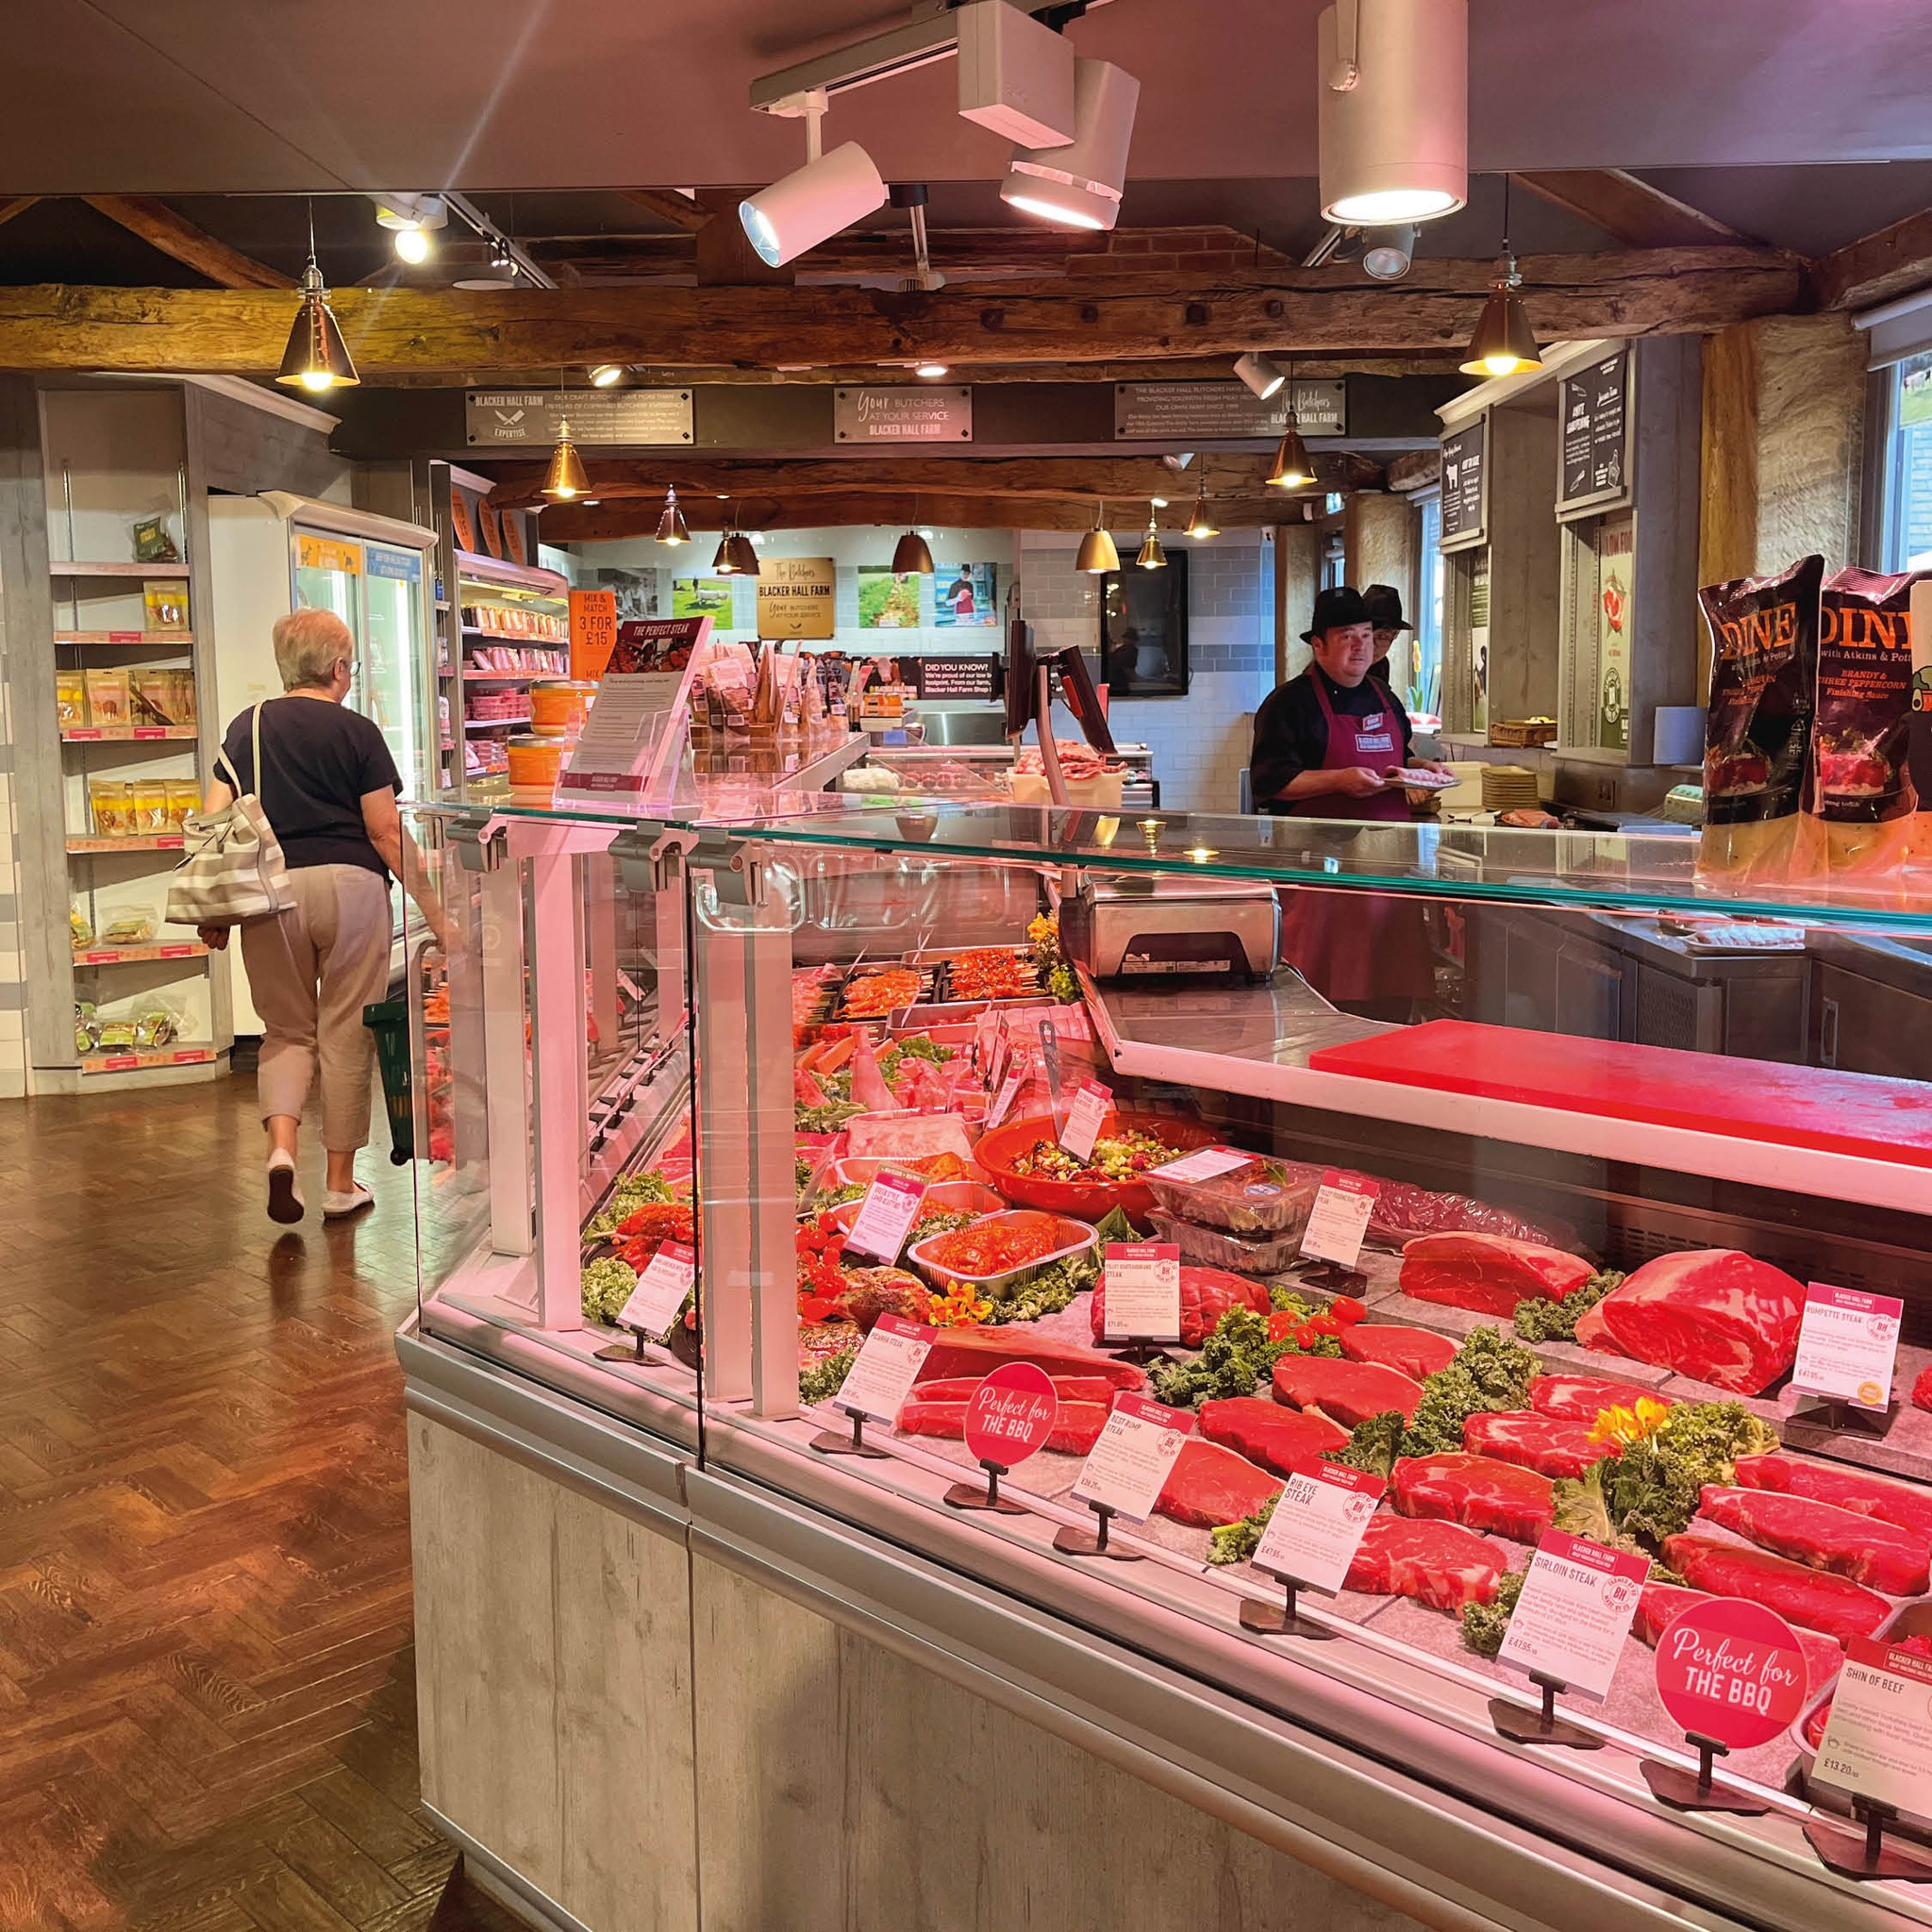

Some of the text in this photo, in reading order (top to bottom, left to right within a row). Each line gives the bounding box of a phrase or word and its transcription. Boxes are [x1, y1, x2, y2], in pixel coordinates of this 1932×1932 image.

[475, 396, 543, 406] BLACKER HALL FARM
[858, 391, 945, 423] Your BUTCHERS
[869, 411, 949, 421] AT YOUR SERVICE
[1271, 413, 1300, 425] BLACR
[1302, 413, 1319, 424] HALL
[1319, 413, 1338, 424] FARM
[494, 427, 526, 438] EXPERTISE
[870, 424, 941, 435] BLACKER HALL FARM
[758, 585, 830, 596] BLACKER HALL FARM
[600, 594, 606, 603] &
[584, 604, 608, 613] MATCH
[579, 617, 611, 630] 3 FOR
[633, 623, 691, 636] THE PERFECT STEAK
[1720, 602, 1796, 660] DINE
[585, 632, 608, 645] £15
[1821, 650, 1911, 662] with Atkins & Pott
[1841, 670, 1879, 679] BRANDY
[1849, 679, 1907, 690] PEPPERCORN
[1826, 688, 1864, 699] Finishing
[1841, 1313, 1864, 1324] STEAK
[1877, 1322, 1889, 1332] BH
[977, 1387, 1052, 1422] Perfect for
[1111, 1415, 1125, 1426] BEST
[982, 1413, 1034, 1442] THE BBQ
[1106, 1424, 1124, 1436] STEAK
[1289, 1477, 1319, 1496] RIB EYE
[1285, 1489, 1315, 1507] STEAK
[1353, 1501, 1365, 1513] BH
[1534, 1557, 1598, 1588] SIRLOIN STEAK
[1613, 1587, 1628, 1602] BH
[1674, 1627, 1799, 1687] Perfect for
[1889, 1652, 1925, 1670] BLACKER HALL
[1845, 1667, 1906, 1694] SHIN OF BEEF
[1685, 1666, 1773, 1717] THE BBQ
